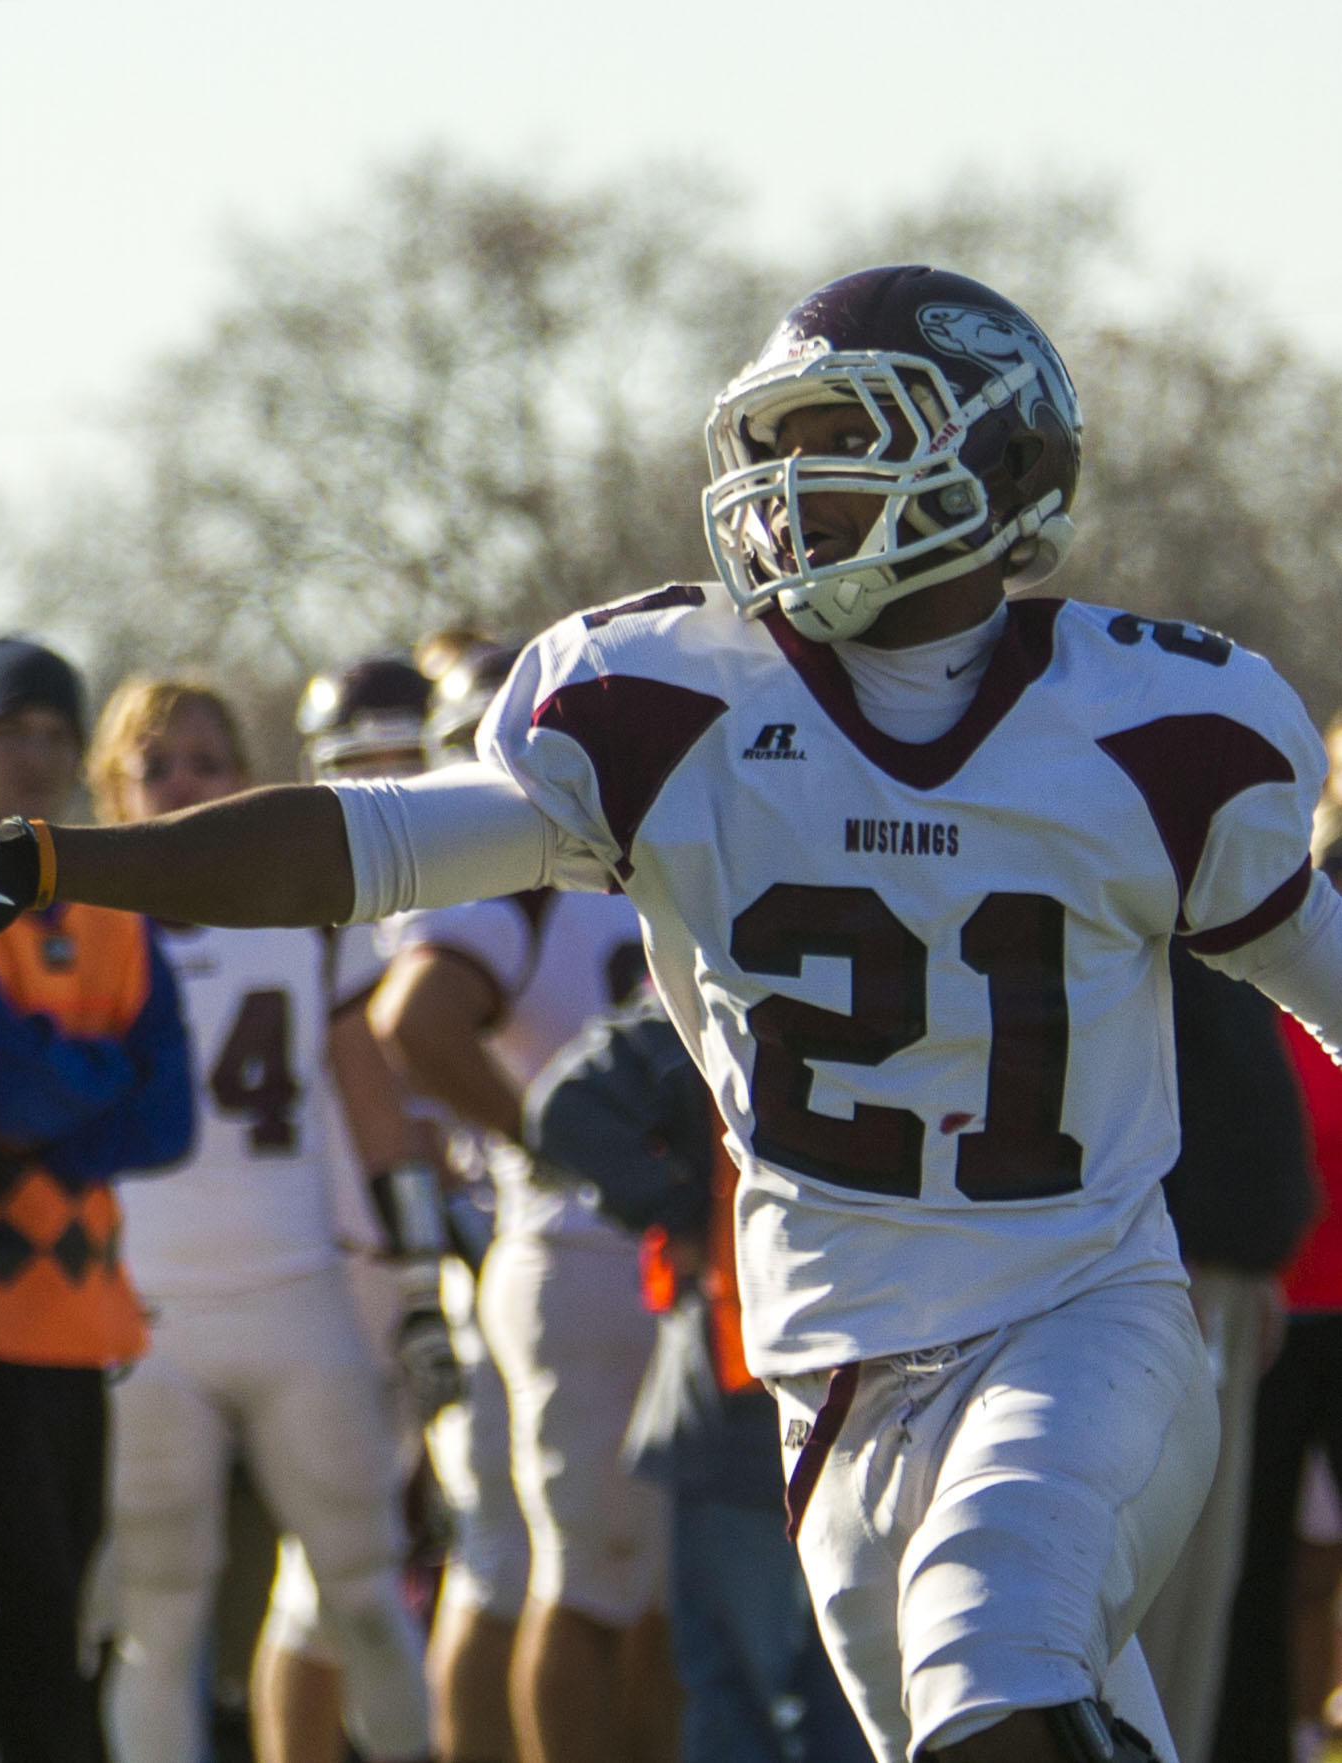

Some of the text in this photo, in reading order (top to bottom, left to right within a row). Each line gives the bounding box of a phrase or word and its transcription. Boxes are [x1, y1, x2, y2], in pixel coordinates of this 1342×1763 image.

[742, 748, 808, 761] RUSSELL
[844, 818, 959, 857] MUSTANGS
[210, 988, 301, 1152] 4
[729, 882, 1085, 1202] 21
